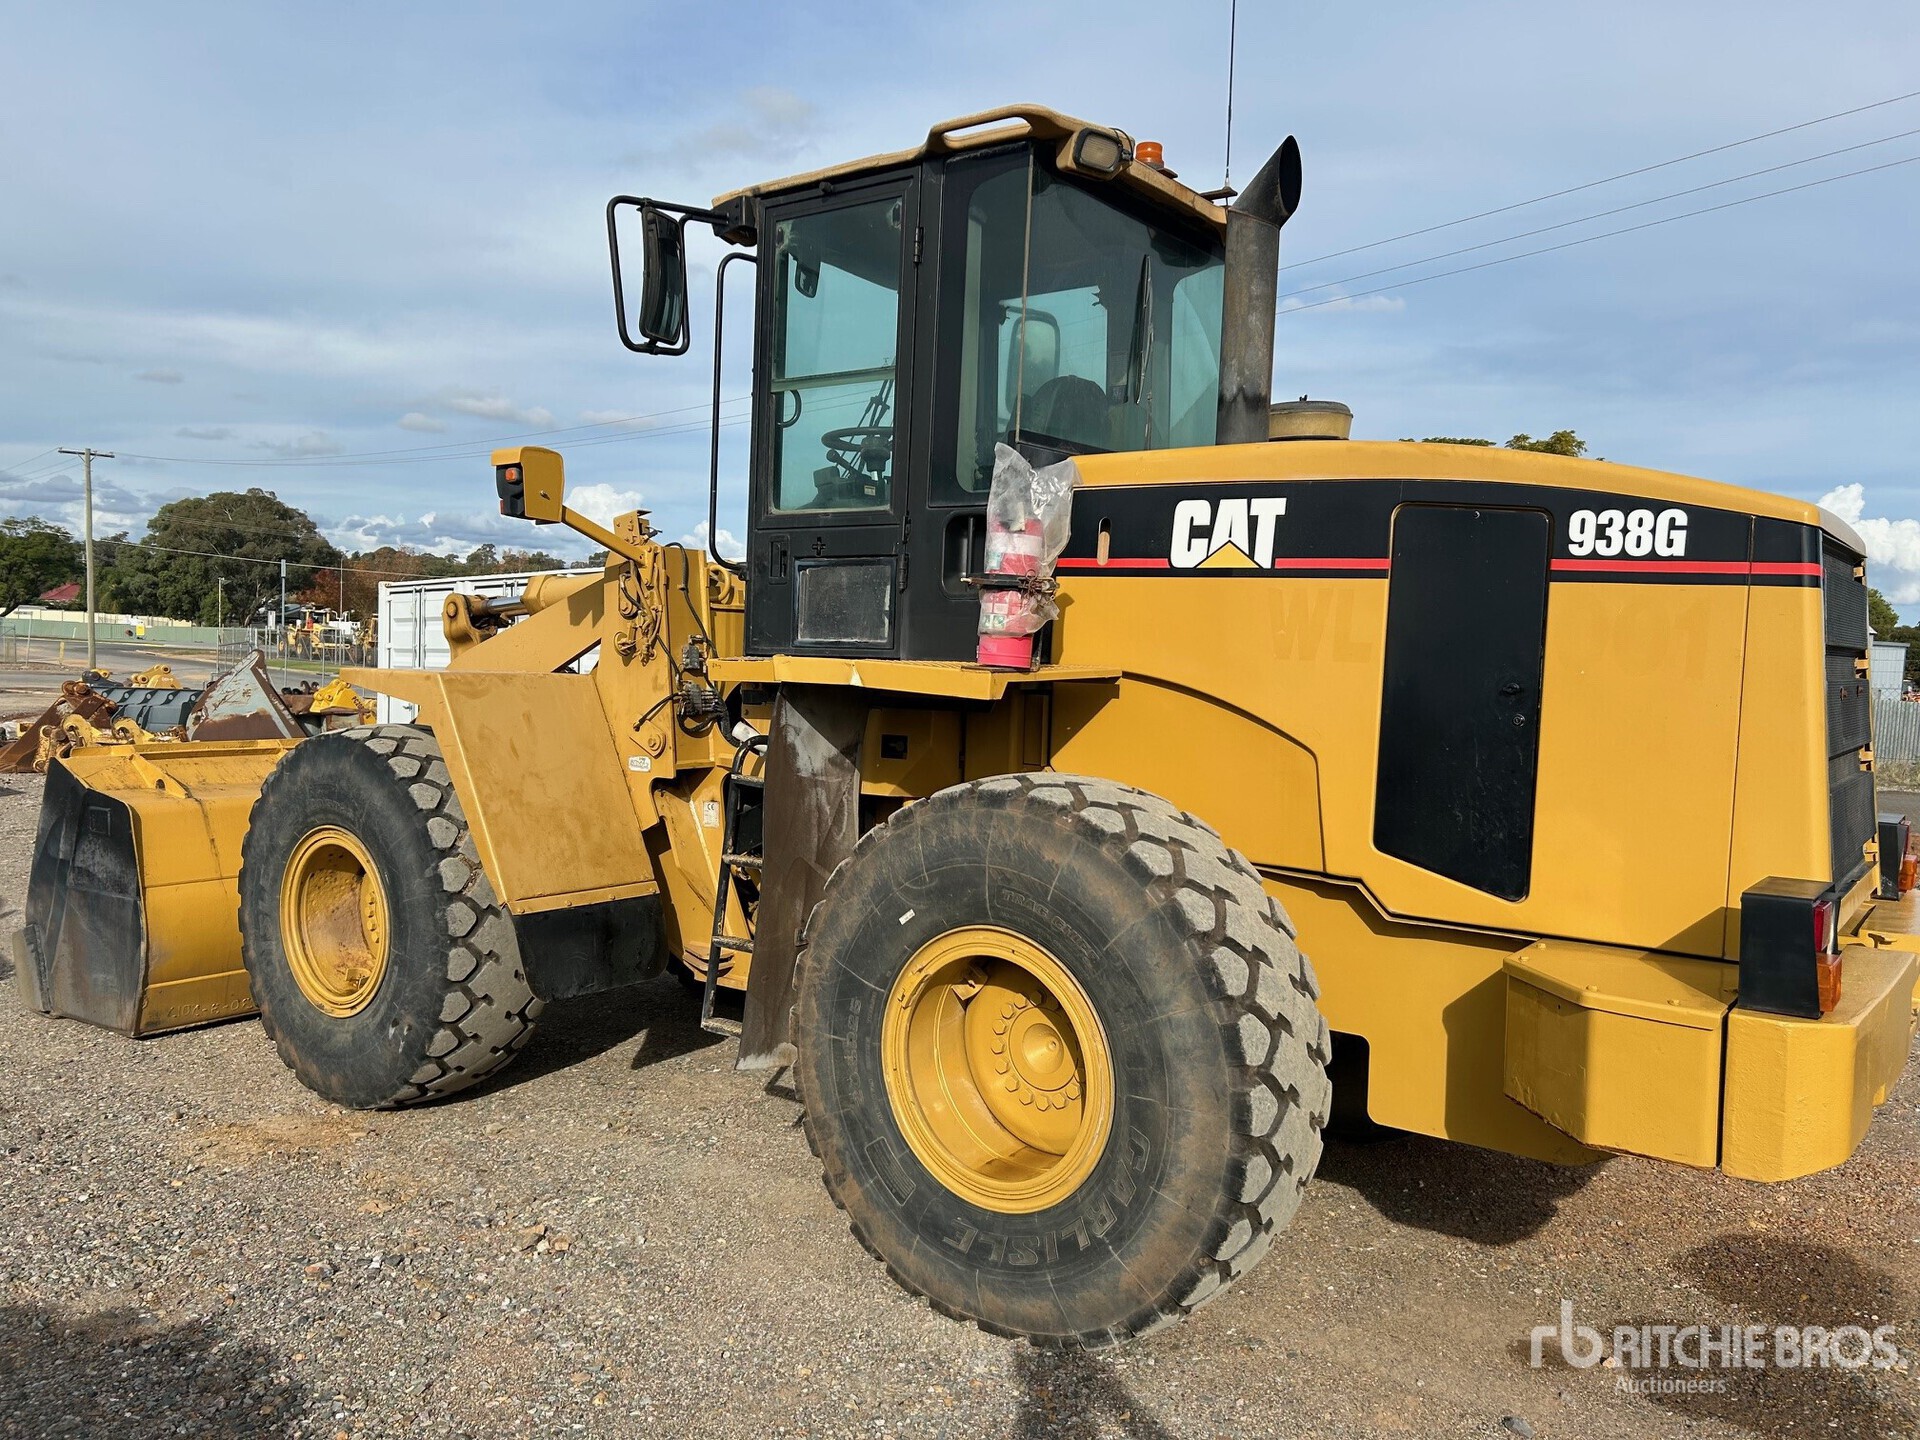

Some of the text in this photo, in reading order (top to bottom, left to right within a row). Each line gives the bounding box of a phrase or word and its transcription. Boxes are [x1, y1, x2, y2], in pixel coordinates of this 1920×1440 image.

[1170, 498, 1287, 569] CAT
[1568, 508, 1688, 557] 938G
[942, 1126, 1150, 1266] CARLISLE
